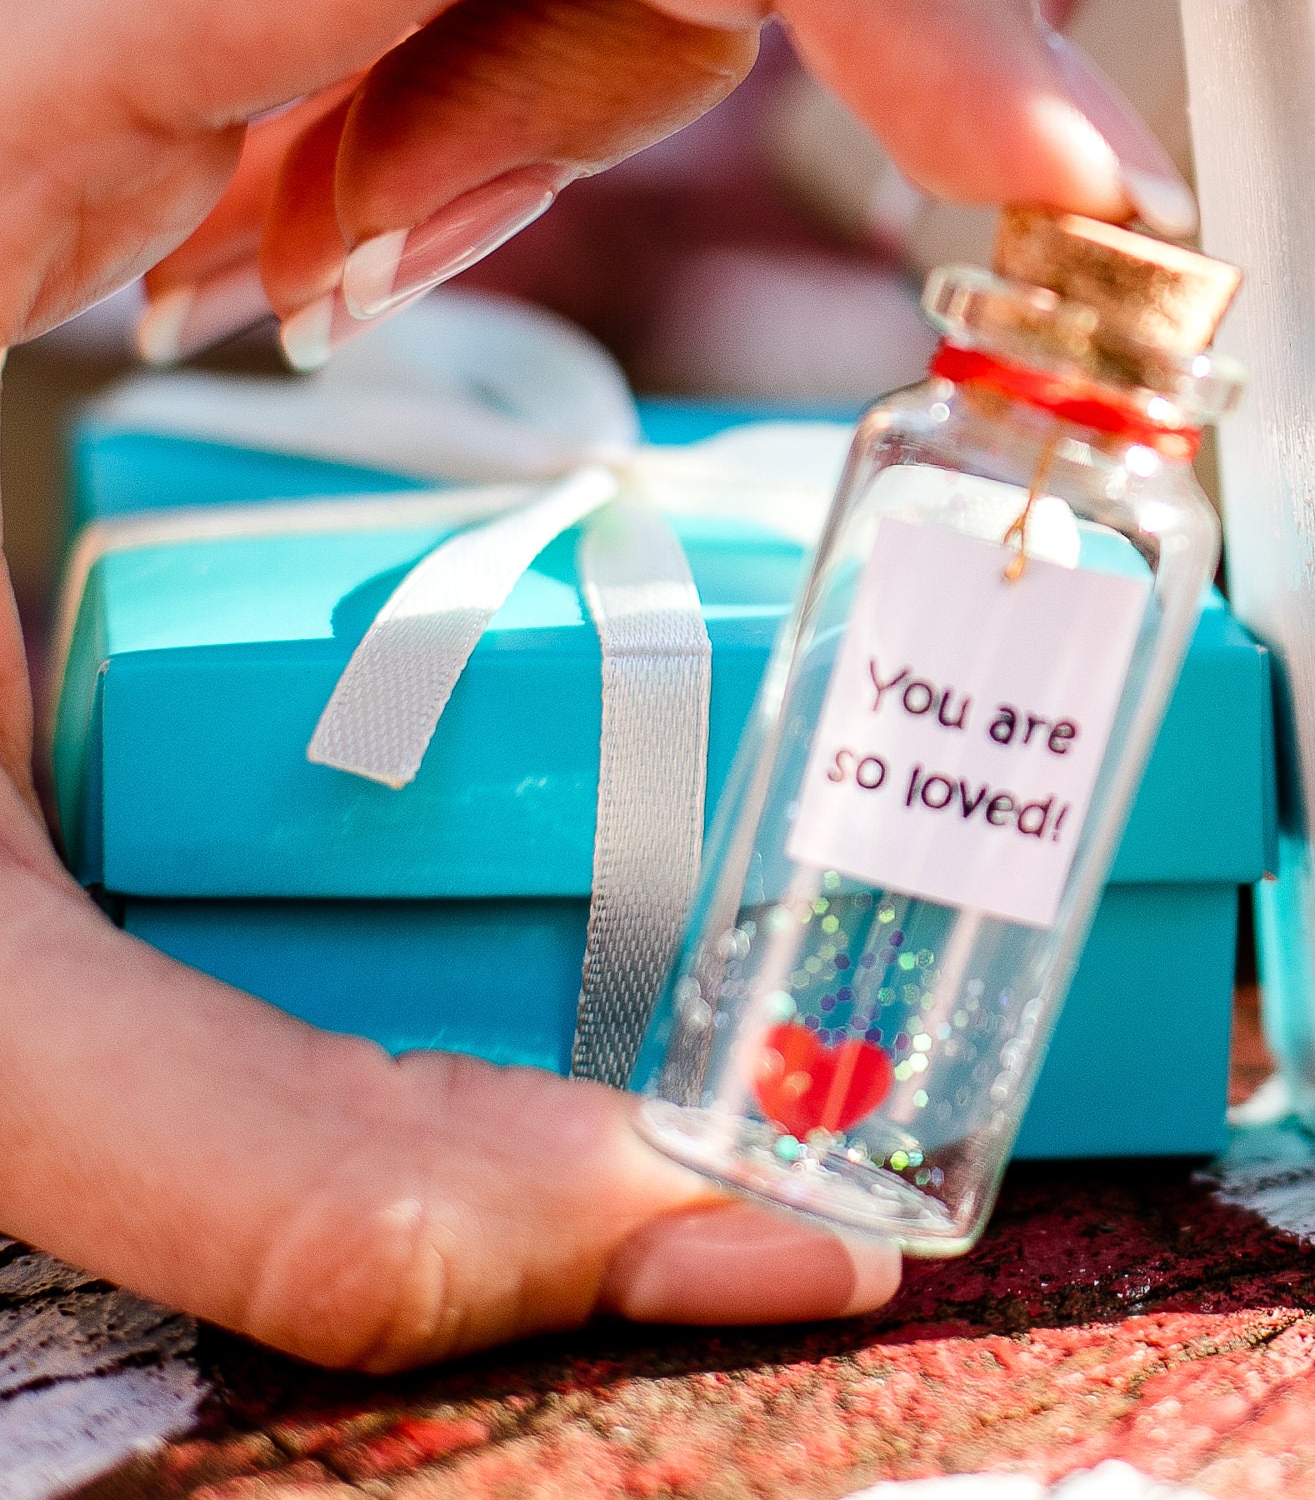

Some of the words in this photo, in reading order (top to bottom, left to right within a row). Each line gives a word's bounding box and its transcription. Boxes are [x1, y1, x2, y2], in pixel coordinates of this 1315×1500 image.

[868, 654, 971, 731] You
[989, 706, 1080, 755] are
[827, 748, 886, 790] so
[905, 765, 1070, 843] loved!
